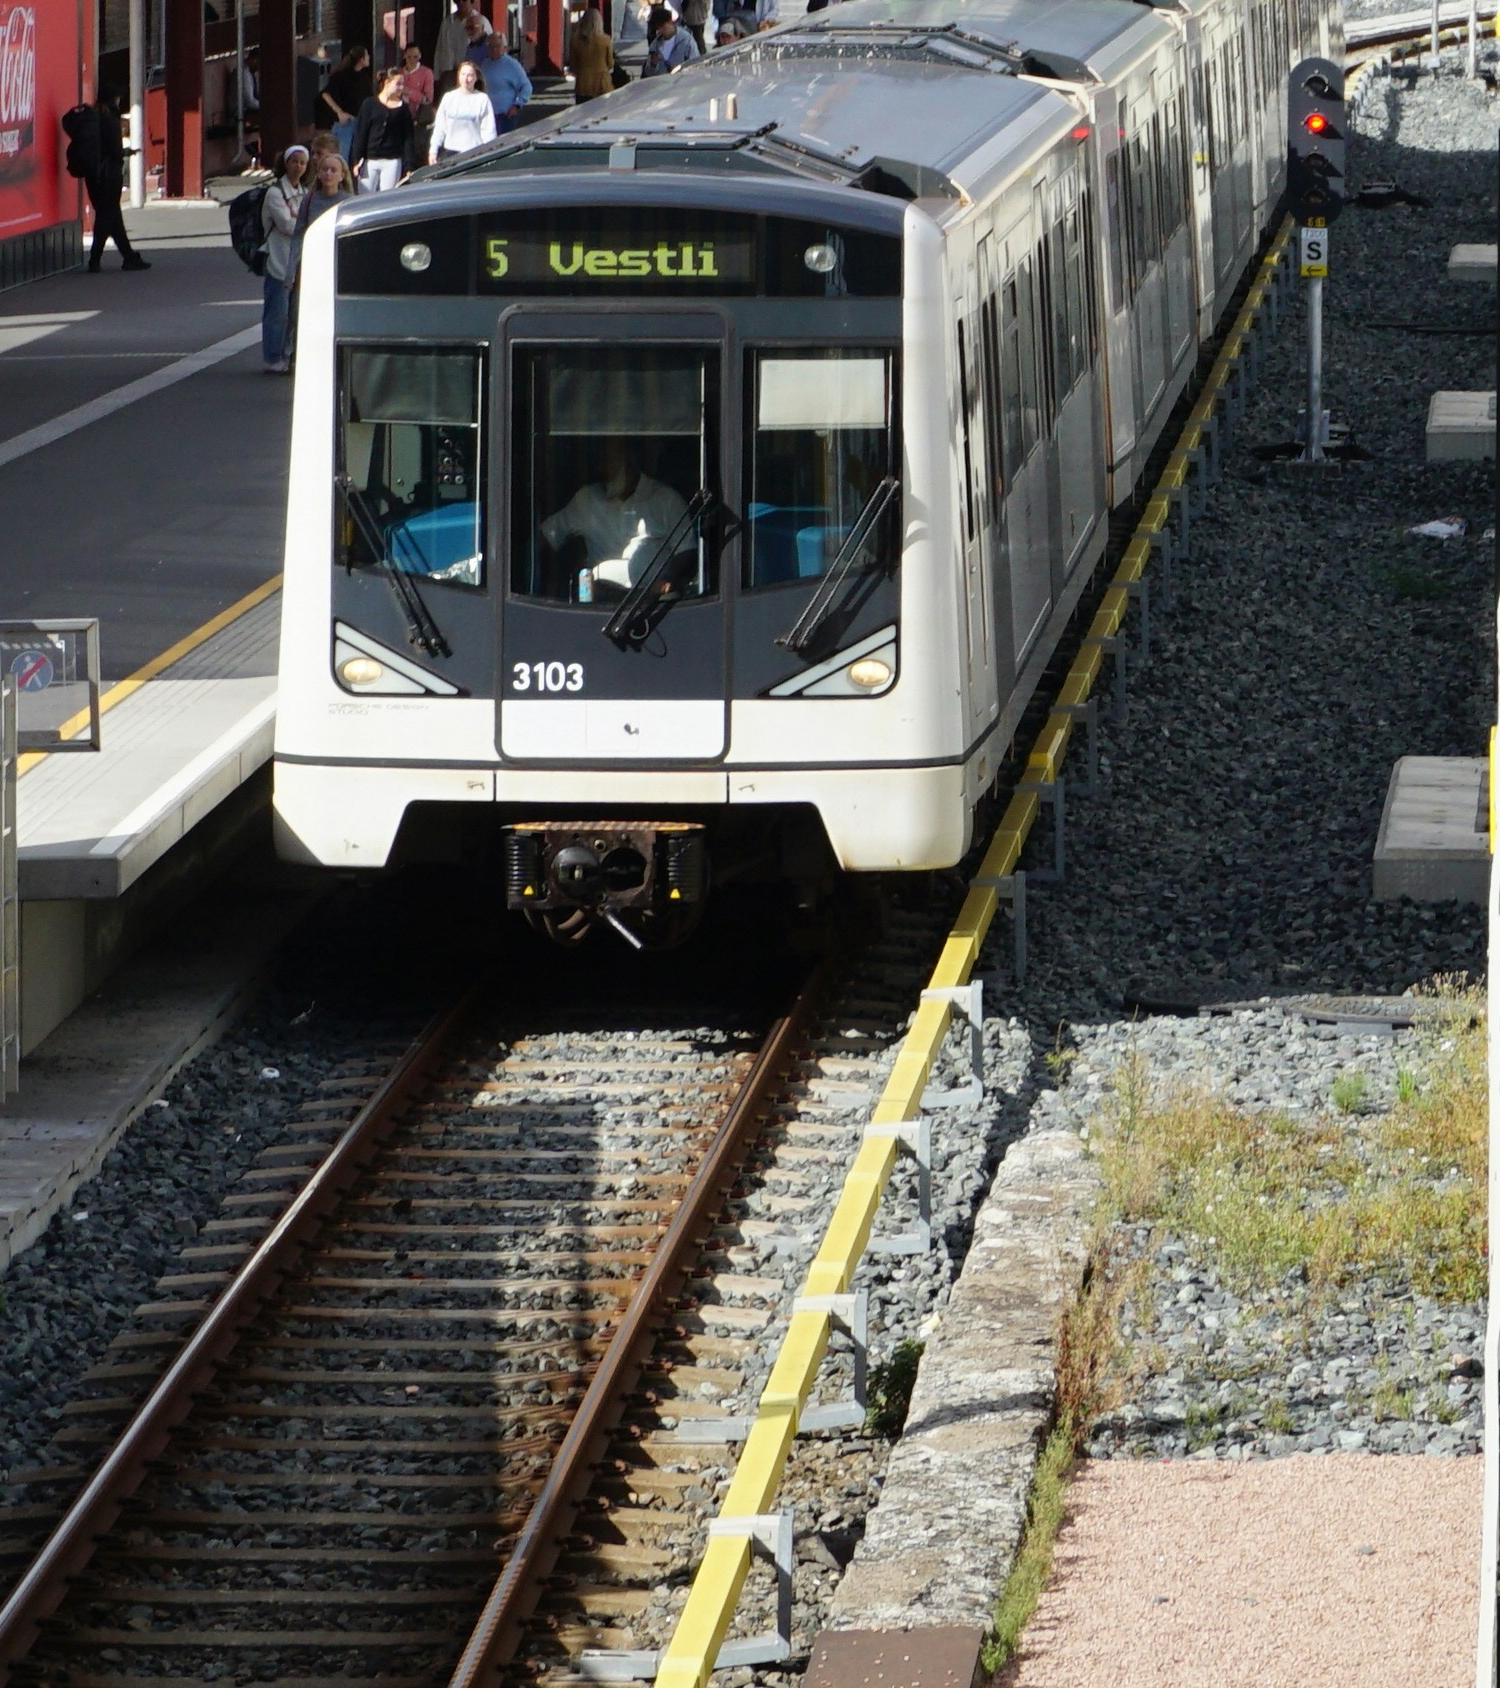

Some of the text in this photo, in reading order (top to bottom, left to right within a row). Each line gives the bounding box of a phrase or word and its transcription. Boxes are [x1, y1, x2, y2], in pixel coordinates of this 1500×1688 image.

[484, 240, 719, 278] 5 Vestli
[1306, 241, 1322, 261] S
[512, 661, 584, 692] 3103
